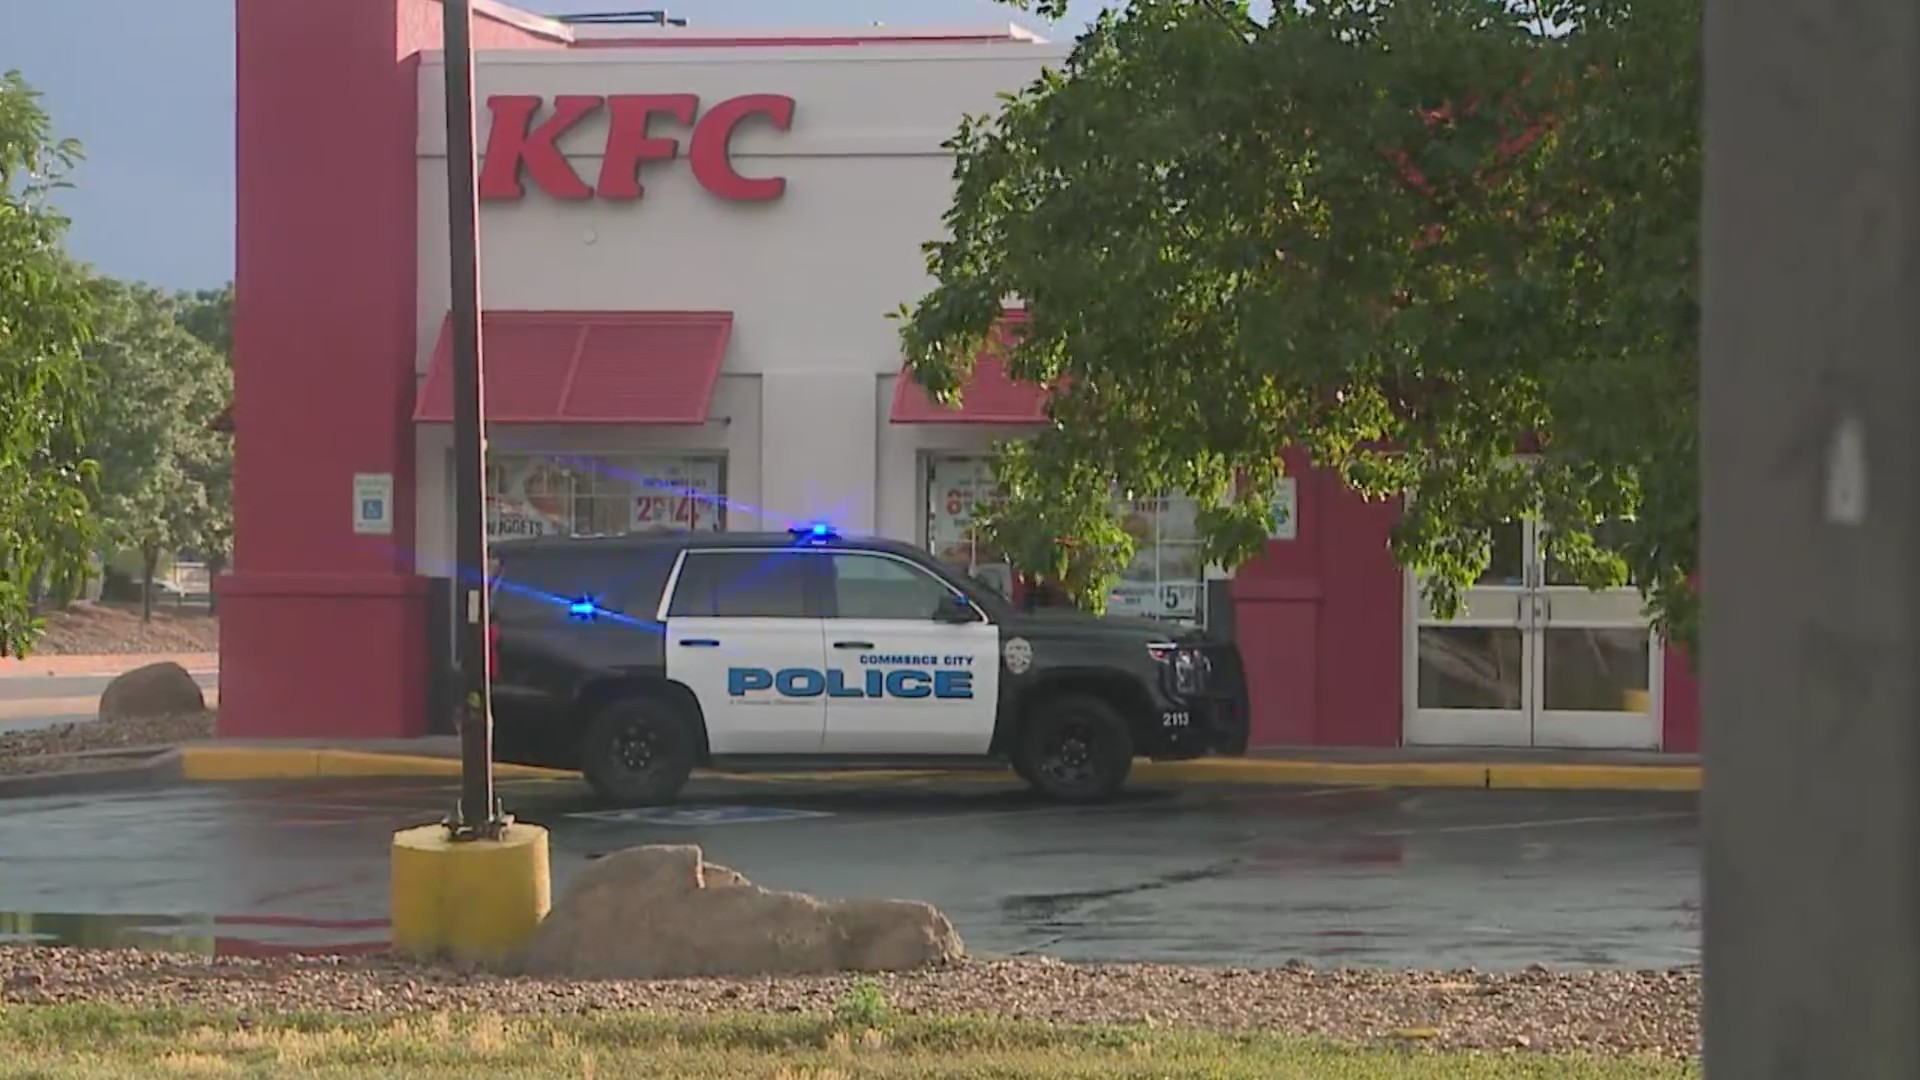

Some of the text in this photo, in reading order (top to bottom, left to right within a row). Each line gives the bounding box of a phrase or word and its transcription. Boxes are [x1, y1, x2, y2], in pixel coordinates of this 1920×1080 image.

[480, 94, 796, 200] KFC
[486, 520, 543, 536] NUGGETS
[860, 655, 974, 665] COMMERCE CITY
[727, 667, 974, 699] POLICE
[1162, 712, 1189, 726] 2113
